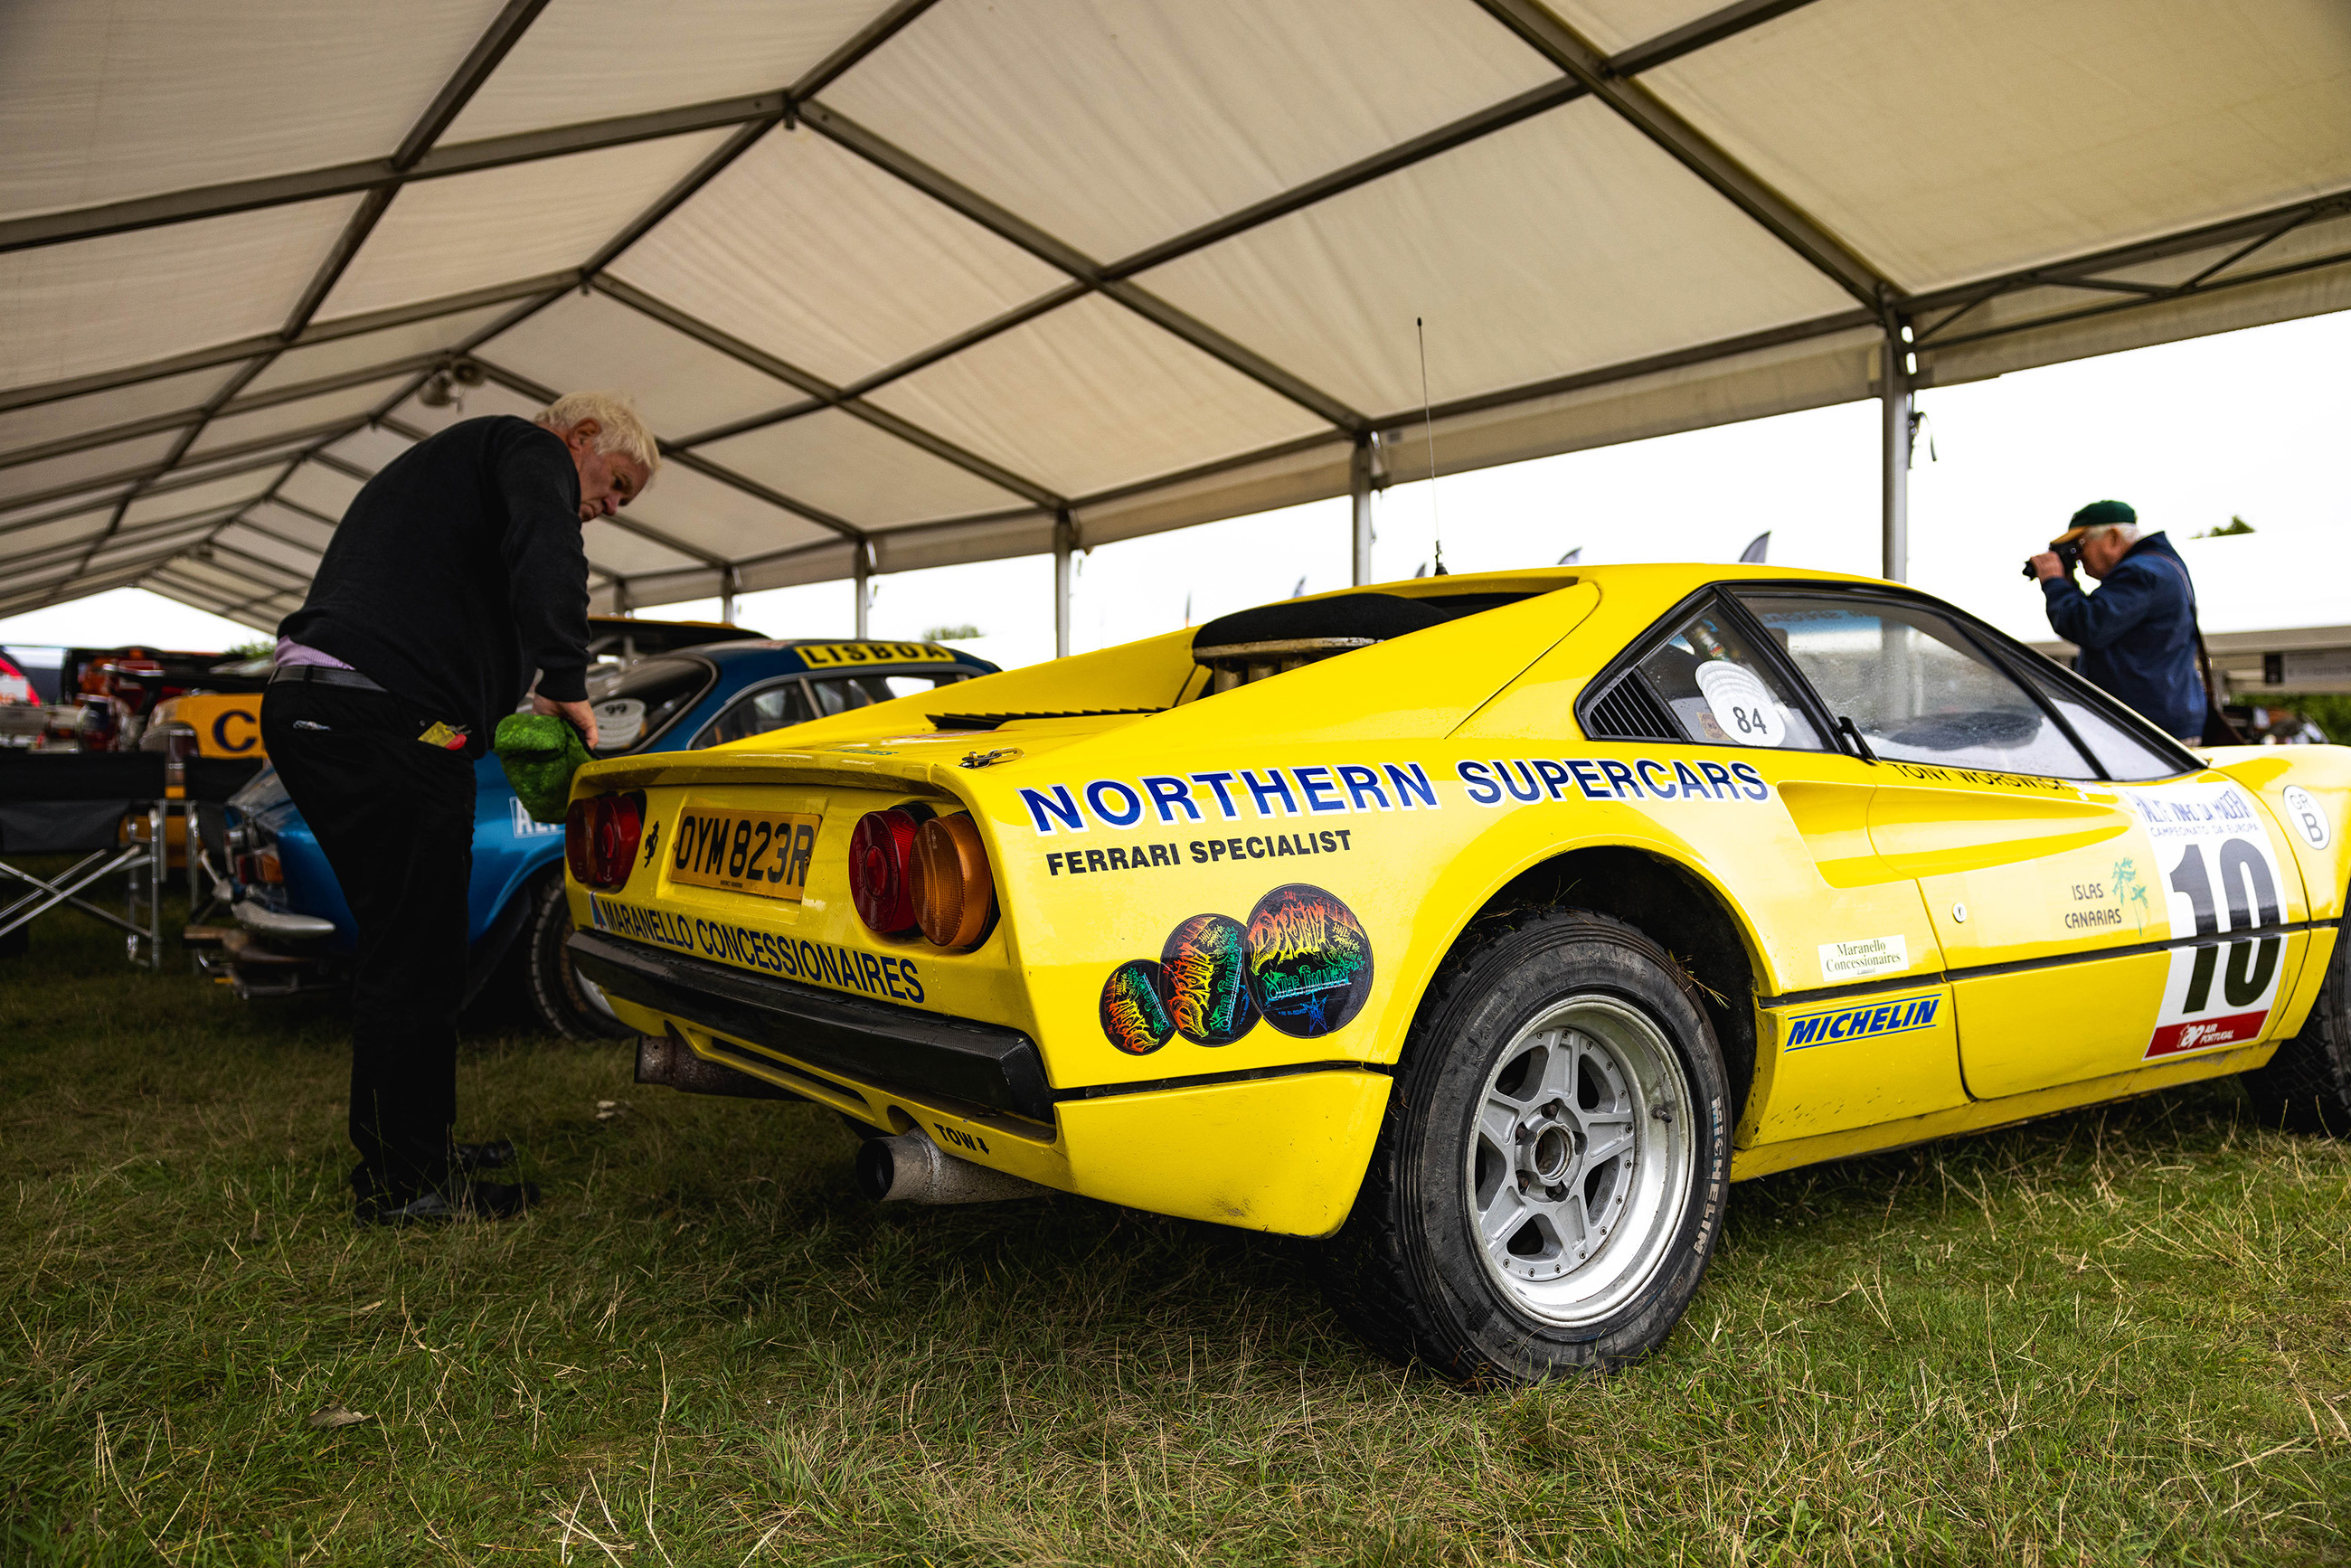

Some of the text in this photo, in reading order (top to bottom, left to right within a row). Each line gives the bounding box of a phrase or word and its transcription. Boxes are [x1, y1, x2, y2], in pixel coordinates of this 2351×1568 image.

[802, 642, 949, 664] LISBOA
[1733, 706, 1768, 734] 84
[1886, 763, 2072, 791] TONY WORSWICK
[1018, 758, 1770, 835] NORTHERN SUPERCARS
[2290, 794, 2313, 810] GR
[2149, 825, 2209, 837] CAMPEONATO
[2212, 824, 2224, 835] DA
[2301, 813, 2323, 842] B
[675, 816, 814, 887] OYM 823R
[1046, 830, 1352, 876] FERRARI SPECIALIST
[2072, 883, 2104, 901] ISLAS
[2064, 908, 2122, 929] CANARIAS
[2169, 837, 2280, 1015] 10
[601, 900, 925, 1004] MARANELLO CONCESSIONAIRES
[1826, 951, 1902, 972] Concessionaires
[1836, 940, 1886, 957] Maranello
[1786, 999, 1940, 1047] MICHELIN
[2199, 1029, 2234, 1044] PORTUGAL
[2205, 1023, 2218, 1034] AIR
[933, 1122, 977, 1151] TOW
